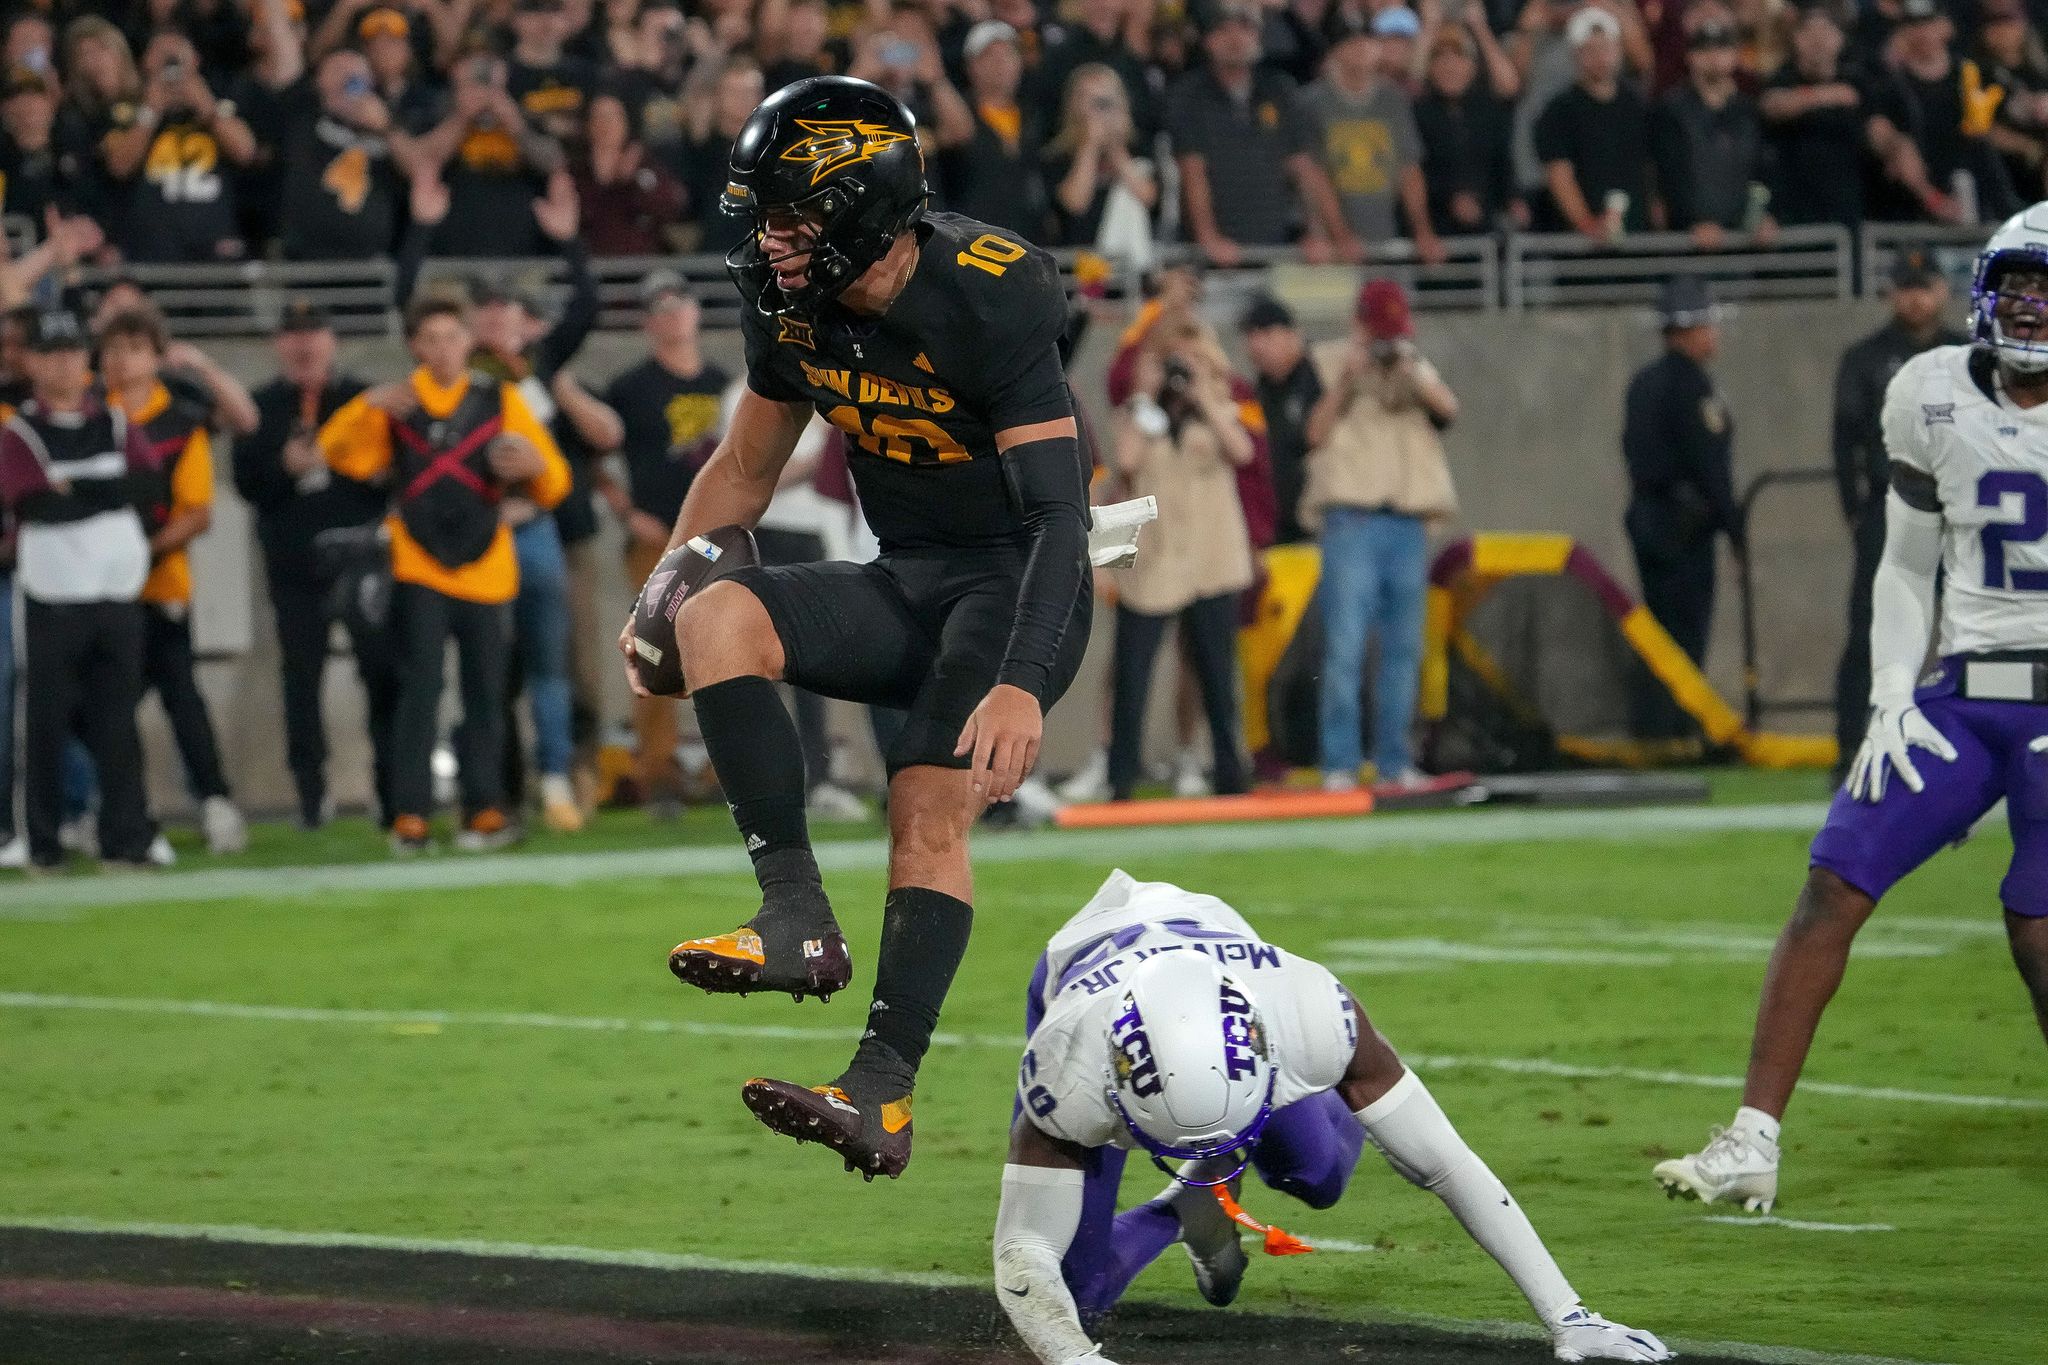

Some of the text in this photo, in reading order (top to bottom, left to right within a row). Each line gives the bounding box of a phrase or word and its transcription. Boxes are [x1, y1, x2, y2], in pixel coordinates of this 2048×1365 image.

[957, 234, 1027, 276] 10
[800, 361, 956, 414] SUN DEVILS
[1070, 943, 1281, 995] McI JR.
[1112, 999, 1165, 1099] TCU
[1220, 983, 1258, 1082] TCU
